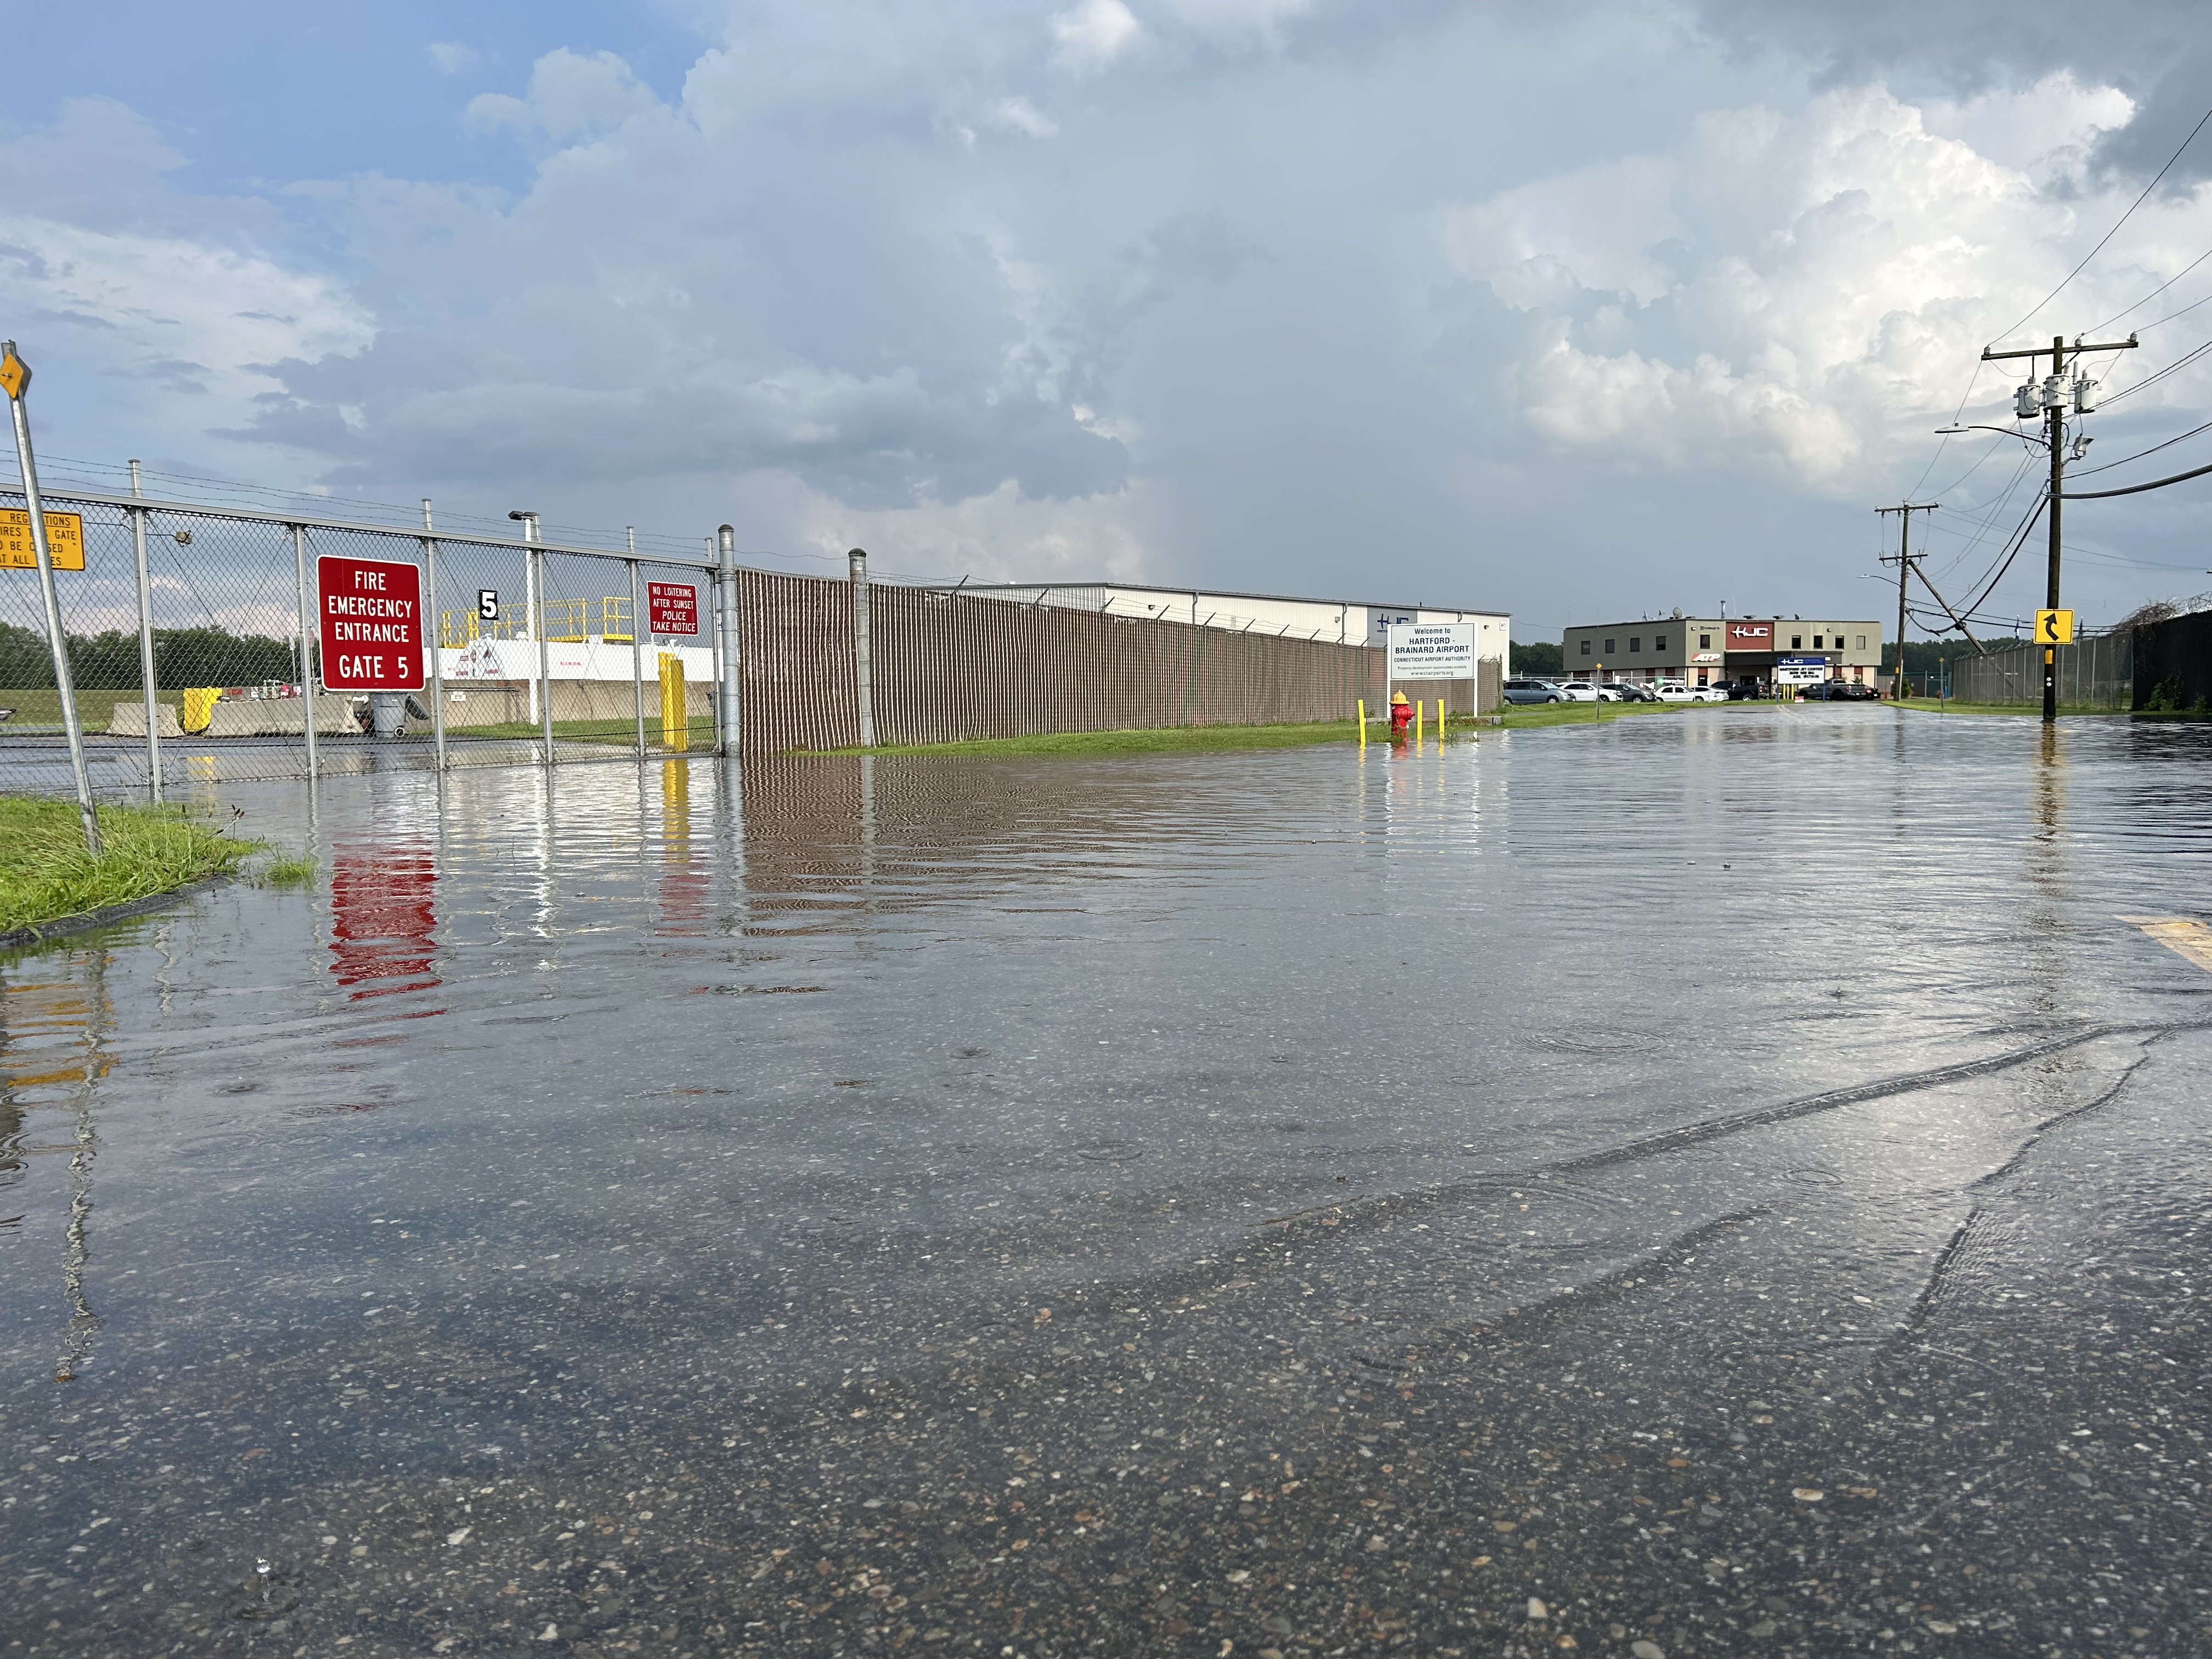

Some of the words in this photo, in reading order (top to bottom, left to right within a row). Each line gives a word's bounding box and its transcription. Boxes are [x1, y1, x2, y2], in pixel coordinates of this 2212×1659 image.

[10, 513, 70, 526] REGTIONS
[55, 529, 76, 540] GATE
[10, 541, 22, 550] BE
[29, 542, 63, 552] CSED
[13, 555, 30, 564] ALL
[355, 571, 386, 591] FIRE
[652, 586, 661, 595] NO
[664, 586, 691, 597] LOITERING
[328, 595, 412, 618] EMERGENCY
[481, 591, 496, 618] 5
[653, 598, 670, 608] AFTER
[673, 599, 693, 610] SUNSET
[662, 611, 686, 621] POLICE
[335, 622, 409, 642] ENTRANCE
[653, 621, 670, 631] TAKE
[672, 622, 696, 632] NOTICE
[1731, 625, 1768, 638] HJC
[1409, 637, 1450, 645] HARTFORD
[1692, 653, 1721, 662] ATP
[339, 654, 384, 678] GATE
[398, 656, 408, 679] 5
